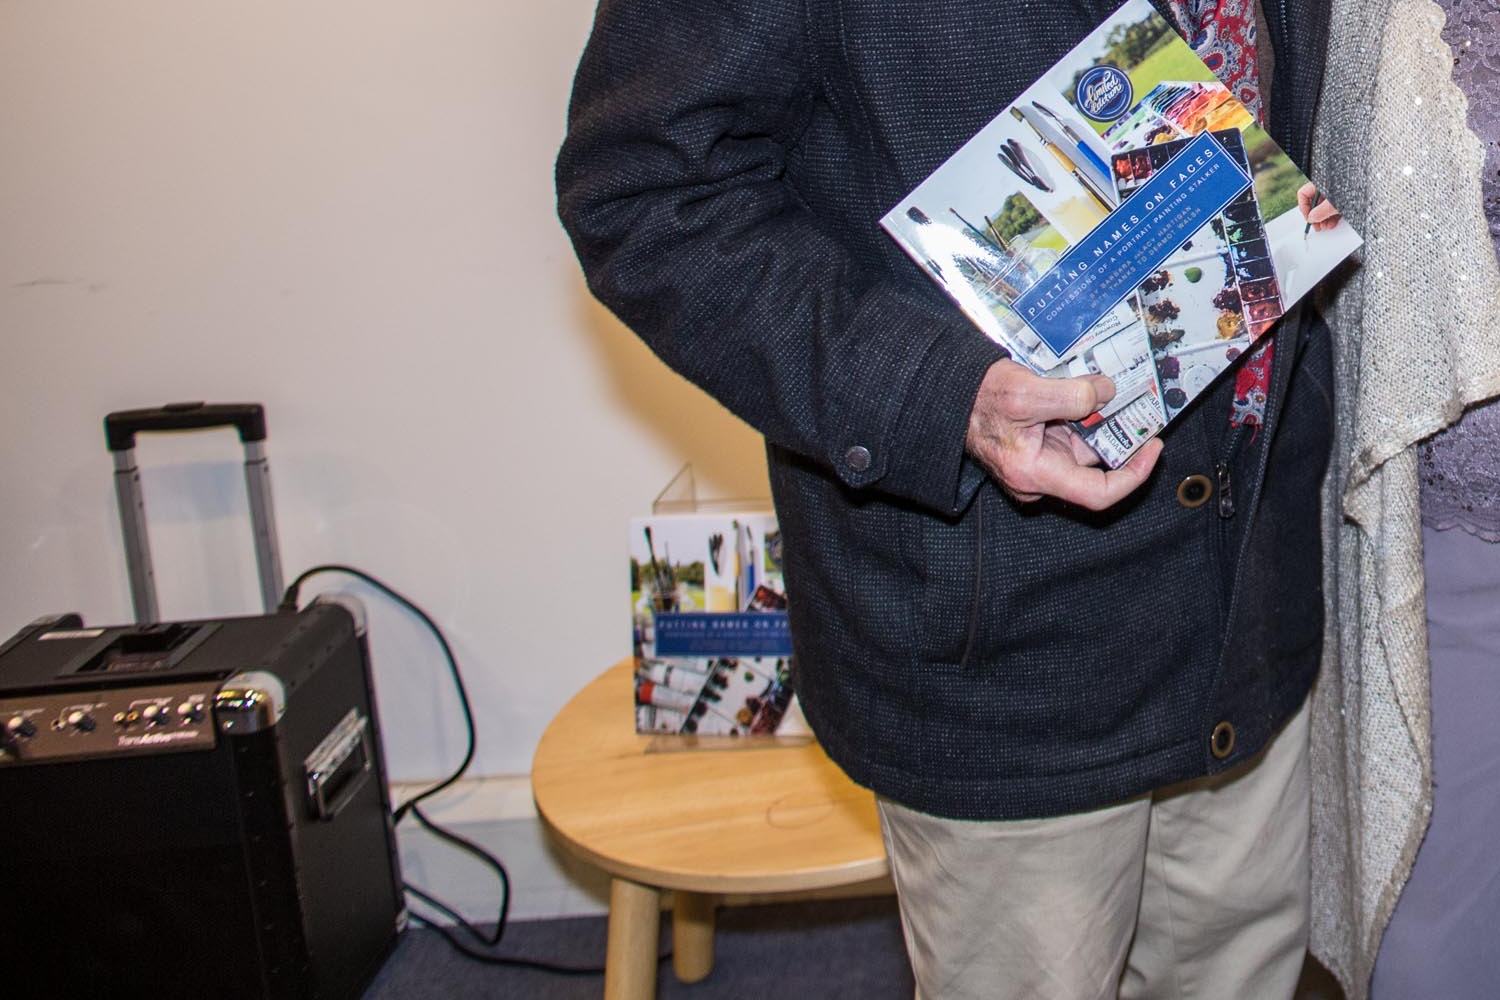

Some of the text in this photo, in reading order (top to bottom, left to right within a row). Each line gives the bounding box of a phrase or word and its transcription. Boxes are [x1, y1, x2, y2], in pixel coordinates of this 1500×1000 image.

[1027, 148, 1213, 317] PUTTING NAMES ON FACES
[1046, 274, 1097, 321] CONFESSIONS
[1097, 262, 1108, 274] OF
[1116, 223, 1152, 256] PORTRAIT
[1153, 192, 1187, 223] PAINTING
[1188, 163, 1220, 193] STALKER
